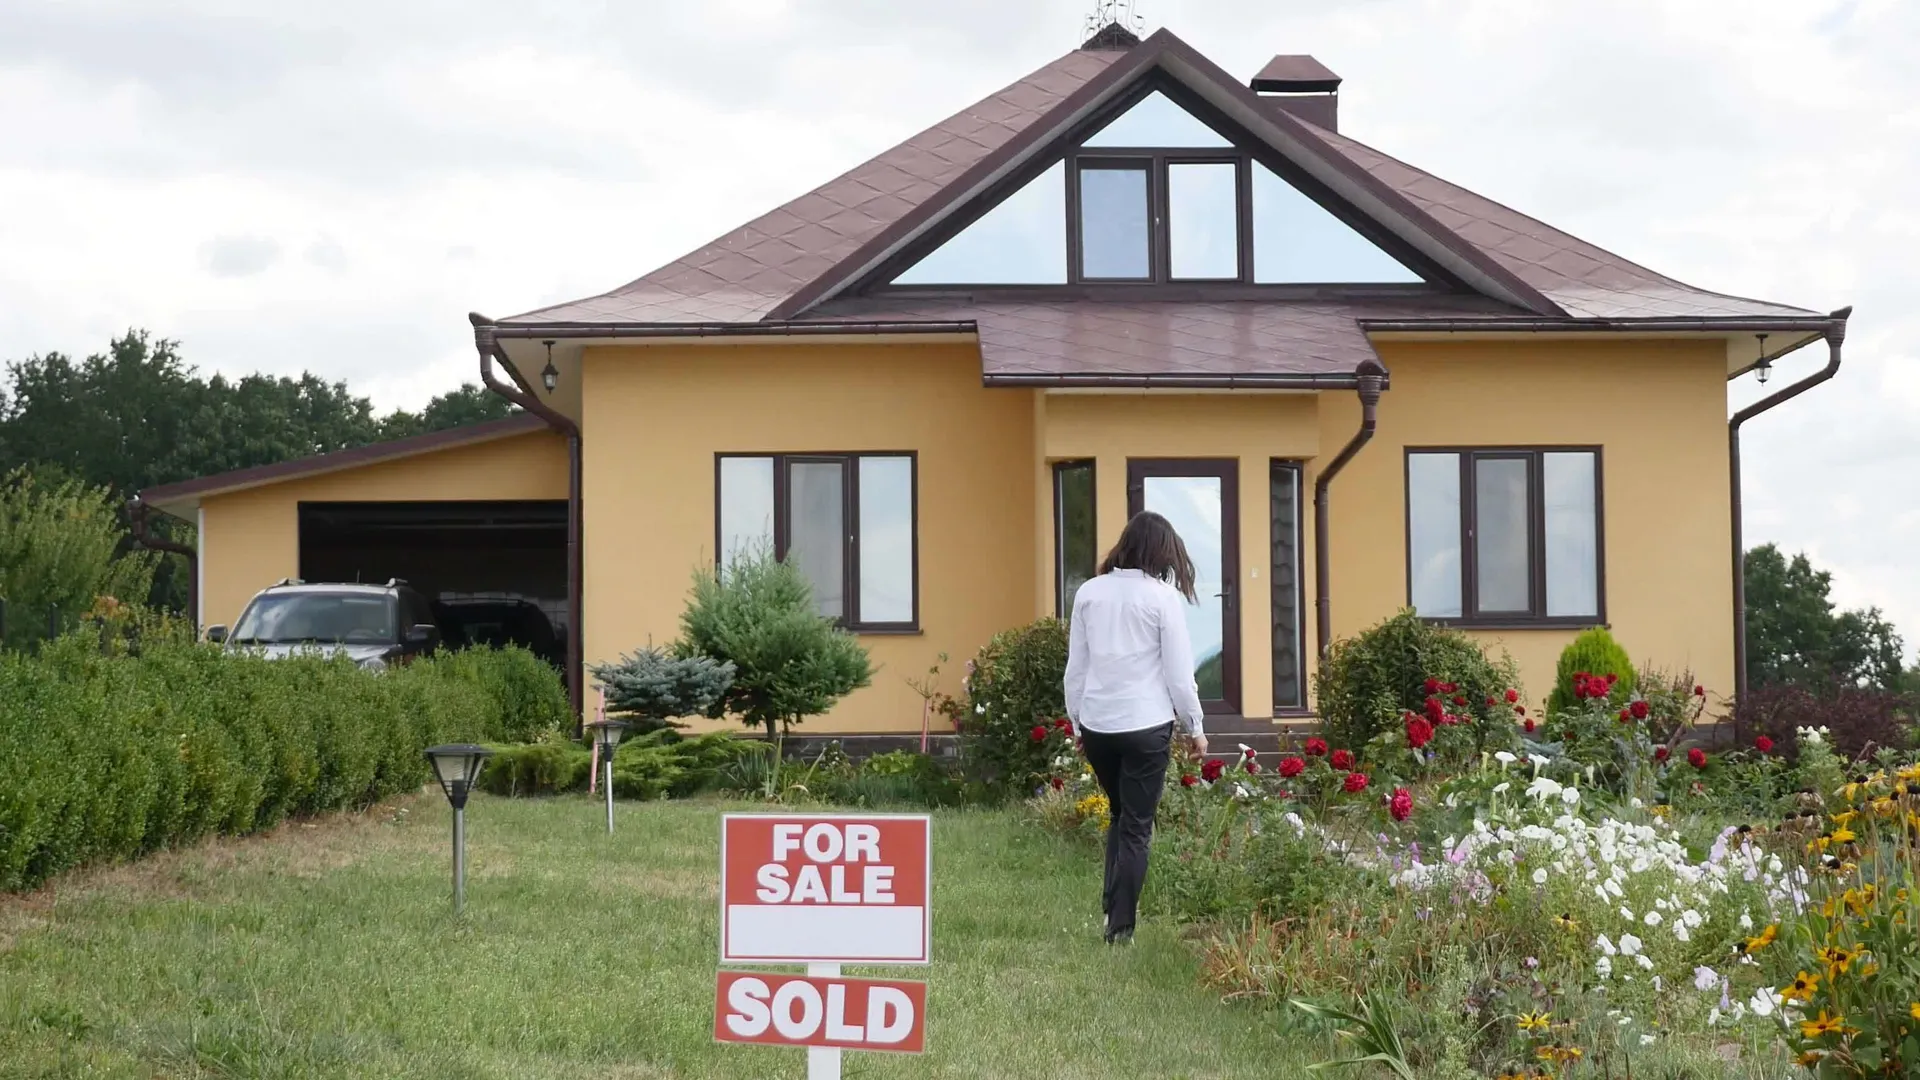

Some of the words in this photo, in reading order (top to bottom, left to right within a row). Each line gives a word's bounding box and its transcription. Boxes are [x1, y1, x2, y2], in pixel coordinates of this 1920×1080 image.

[773, 823, 881, 863] FOR
[756, 863, 895, 904] SALE
[726, 977, 915, 1044] SOLD
